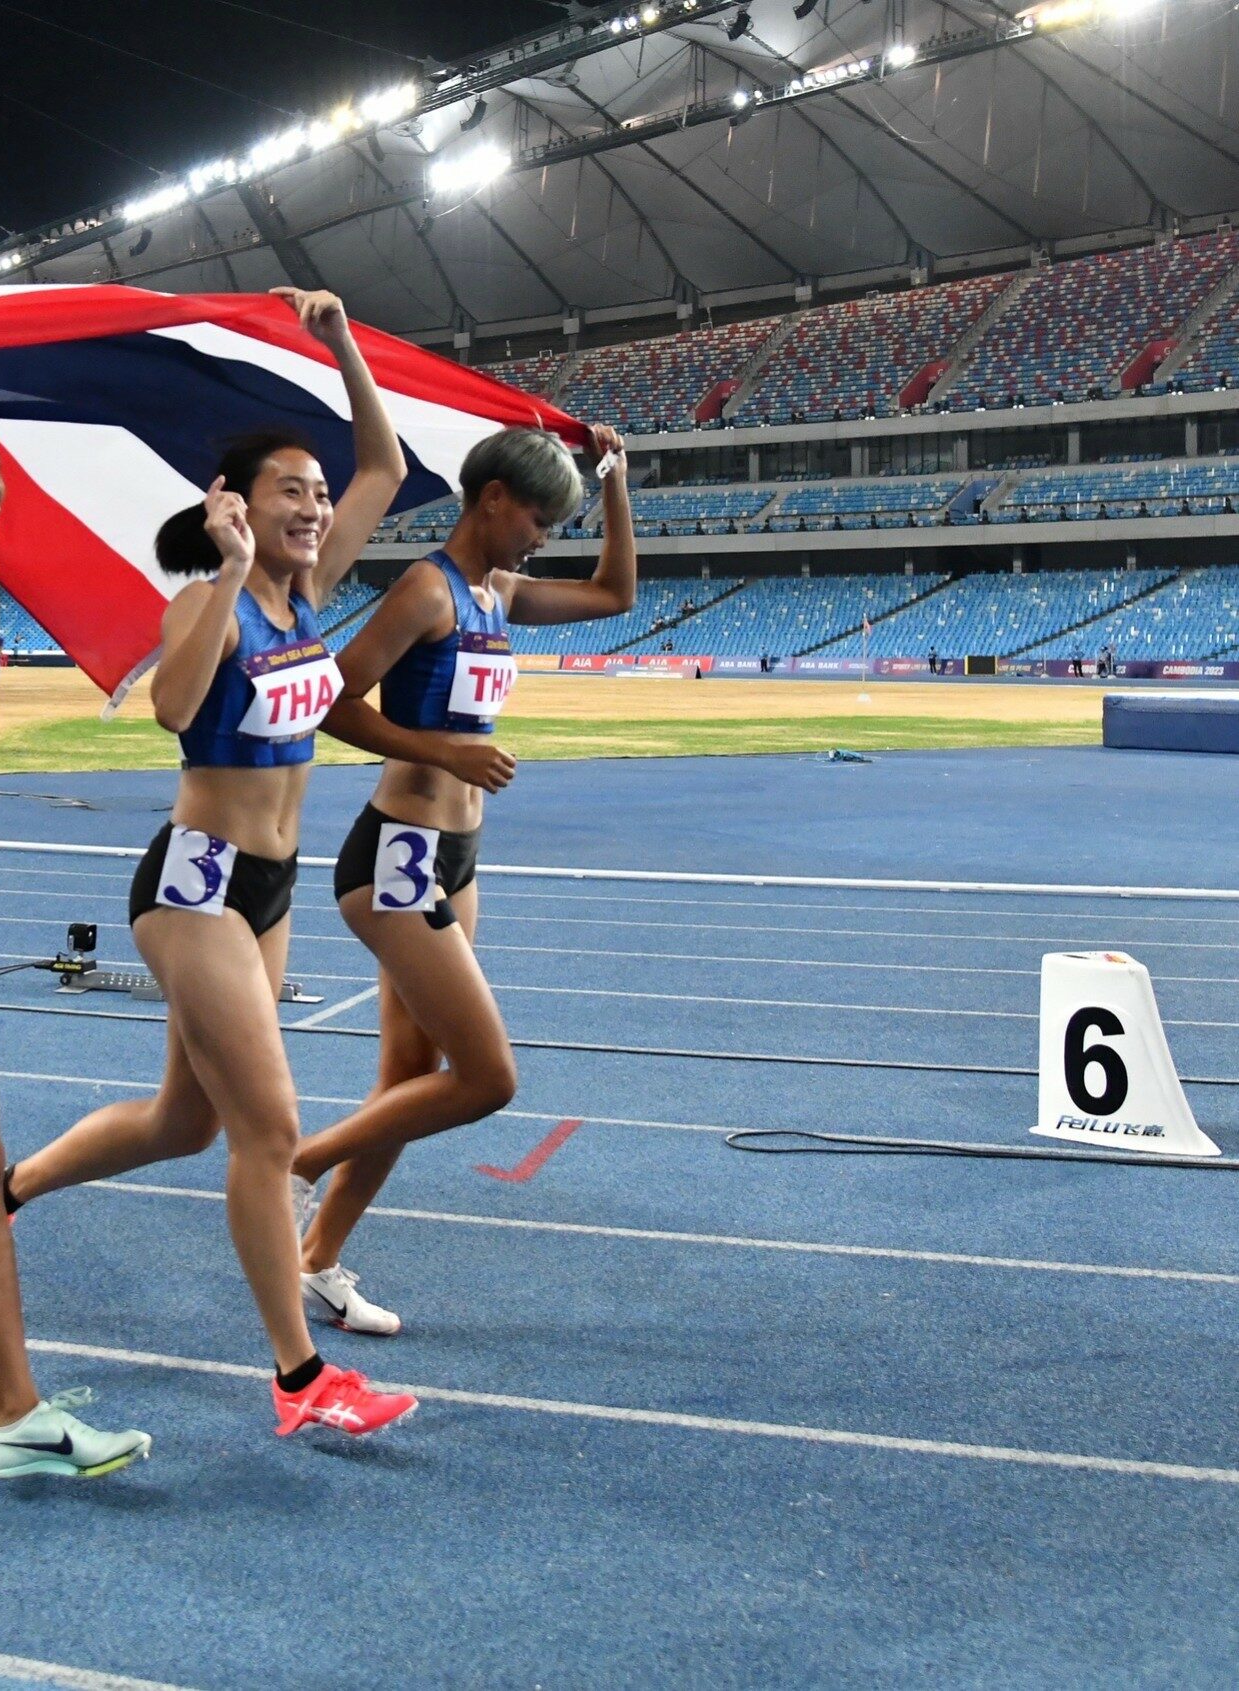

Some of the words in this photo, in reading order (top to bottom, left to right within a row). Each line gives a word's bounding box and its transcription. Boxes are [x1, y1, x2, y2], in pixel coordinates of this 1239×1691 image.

[572, 657, 592, 668] AIA
[1162, 665, 1203, 675] CAMBODIA
[1204, 666, 1224, 676] 2023
[266, 674, 334, 725] THA
[163, 829, 227, 907] 3
[378, 831, 429, 908] 3
[1064, 1006, 1129, 1116] 6
